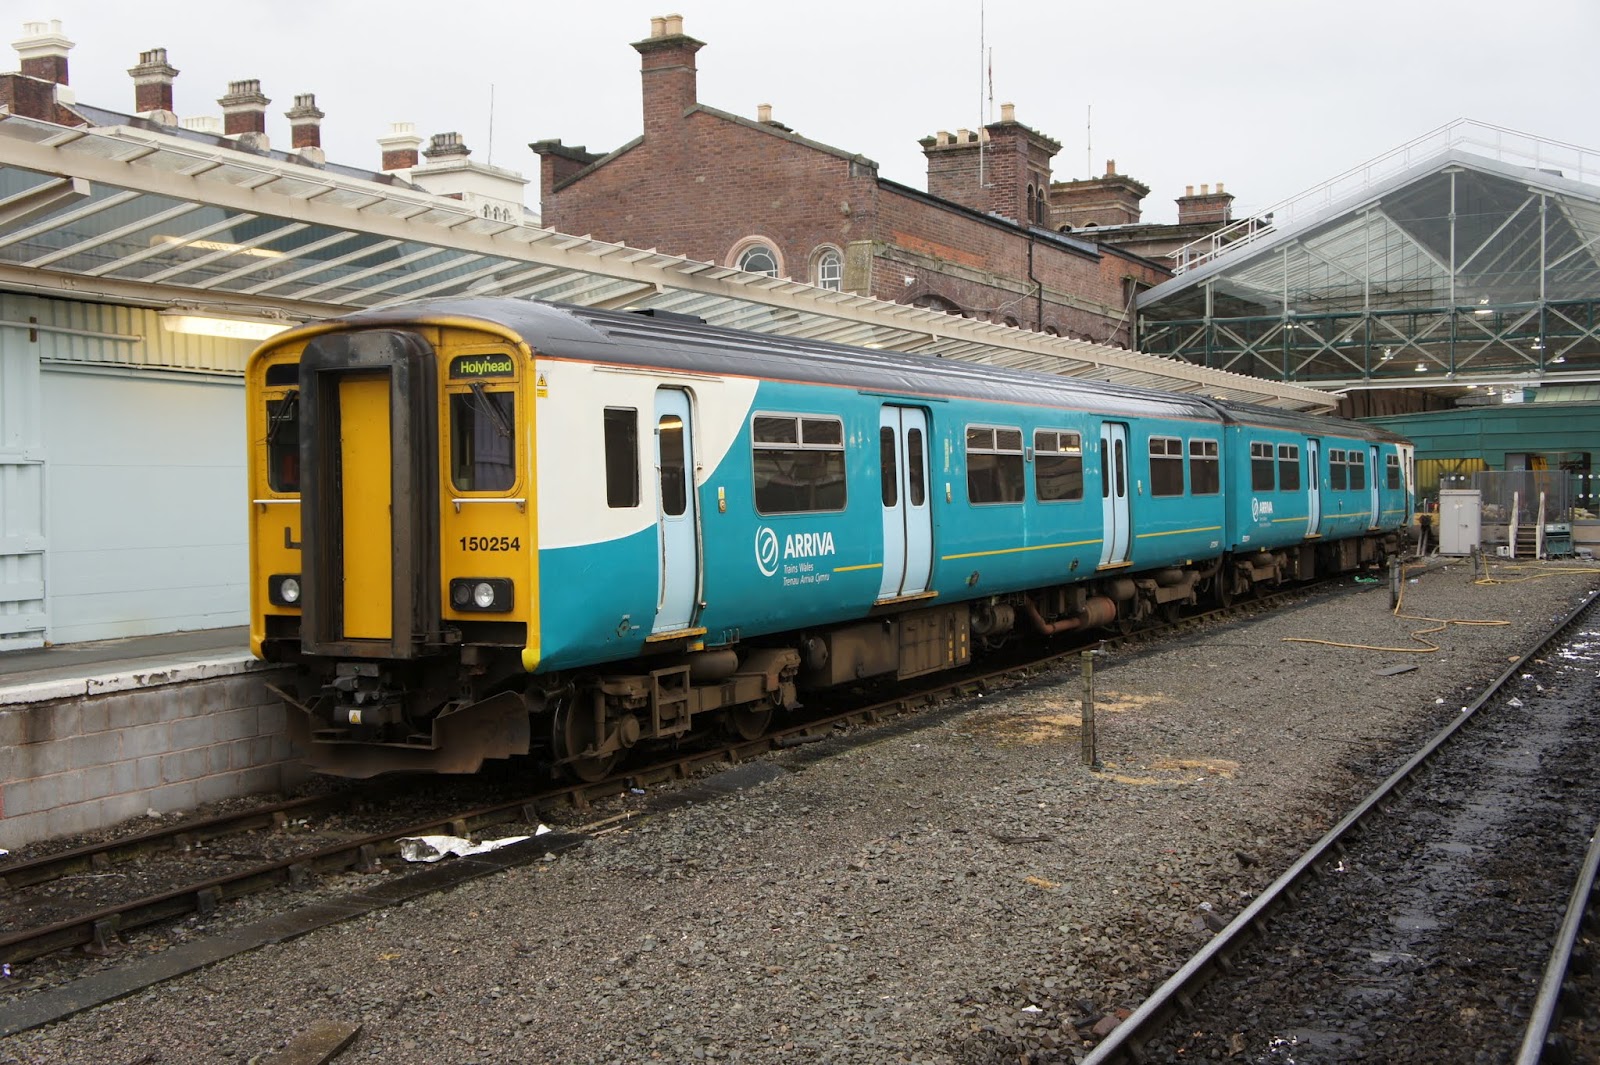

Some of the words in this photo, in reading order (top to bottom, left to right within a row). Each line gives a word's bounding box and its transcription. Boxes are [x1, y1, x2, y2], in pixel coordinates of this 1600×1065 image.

[460, 360, 512, 375] Holyhead
[459, 536, 521, 551] 150254
[783, 532, 835, 559] ARRIVA
[783, 563, 798, 574] Trains
[799, 562, 814, 573] Wales
[799, 574, 815, 584] Arriva
[815, 572, 830, 584] Cymru
